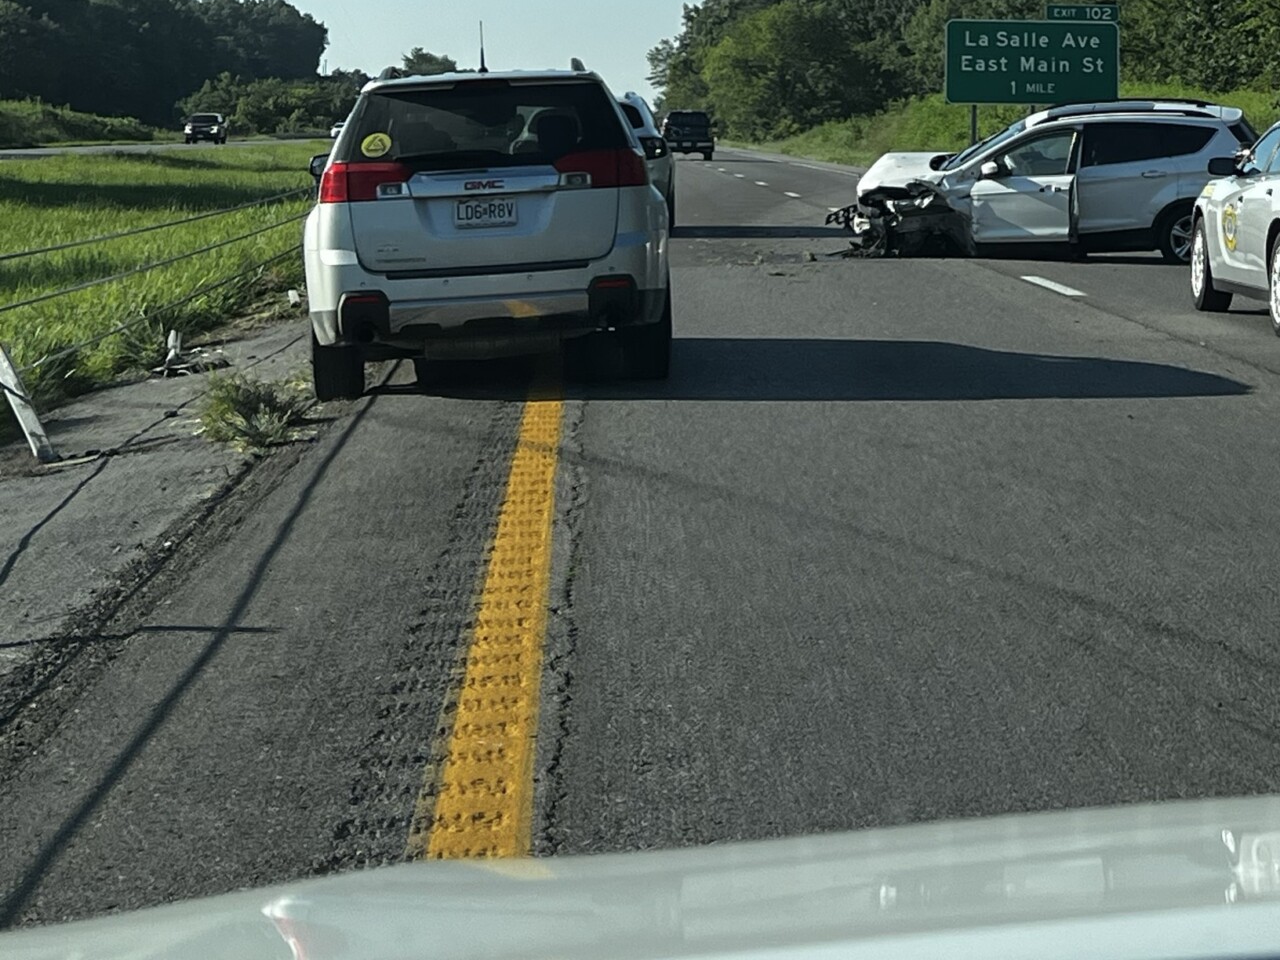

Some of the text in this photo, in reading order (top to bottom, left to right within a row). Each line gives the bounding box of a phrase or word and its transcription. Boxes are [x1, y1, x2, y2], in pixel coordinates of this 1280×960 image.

[1053, 7, 1112, 20] EXIT 102
[964, 30, 1101, 49] La Salle Ave
[961, 55, 1104, 73] East Main St
[1010, 81, 1056, 95] 1 MILE
[464, 179, 505, 190] GMC
